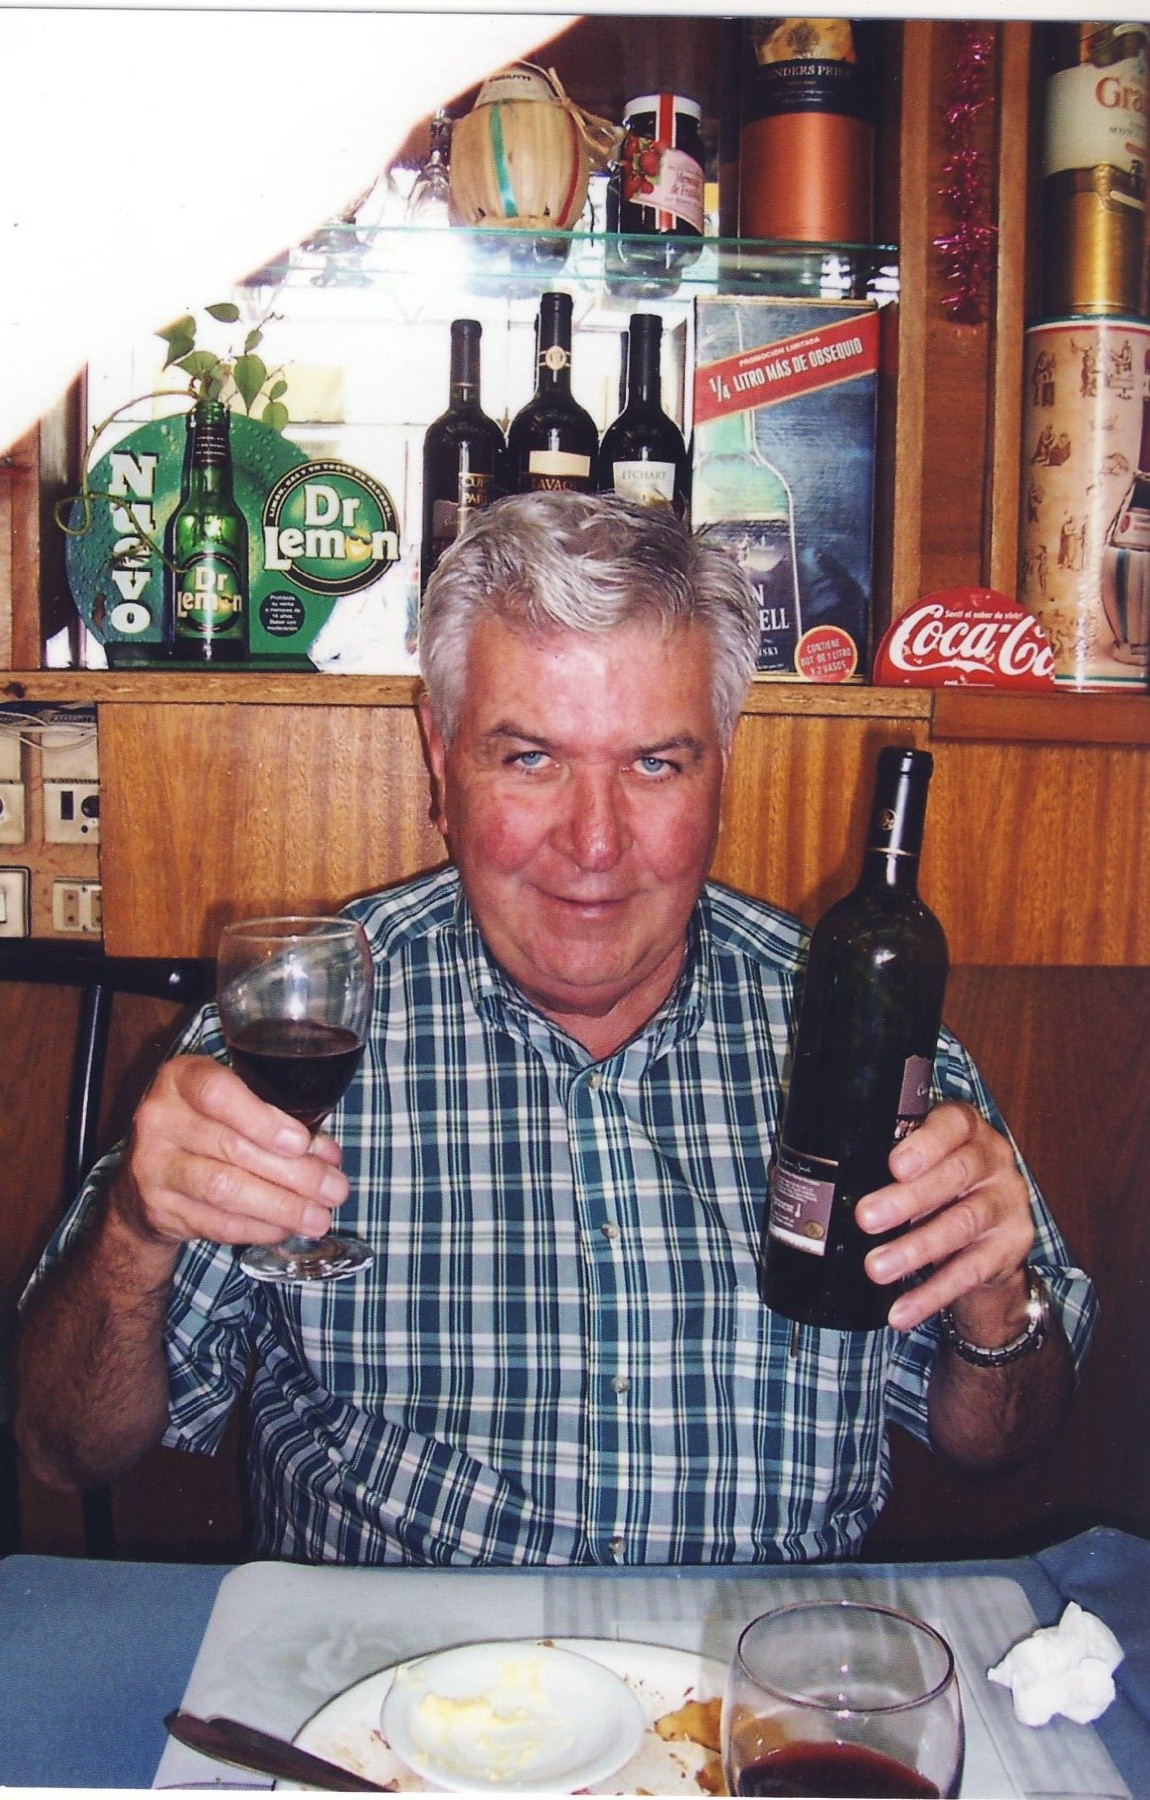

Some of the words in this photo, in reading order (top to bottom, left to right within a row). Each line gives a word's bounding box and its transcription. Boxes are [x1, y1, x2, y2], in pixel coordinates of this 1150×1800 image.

[732, 366, 766, 392] LITRO
[765, 359, 792, 382] MÁS
[792, 356, 808, 374] DE
[808, 336, 864, 368] OBSEQUIO
[304, 484, 360, 527] Dr
[263, 526, 401, 571] Lemon
[195, 565, 228, 591] Dr
